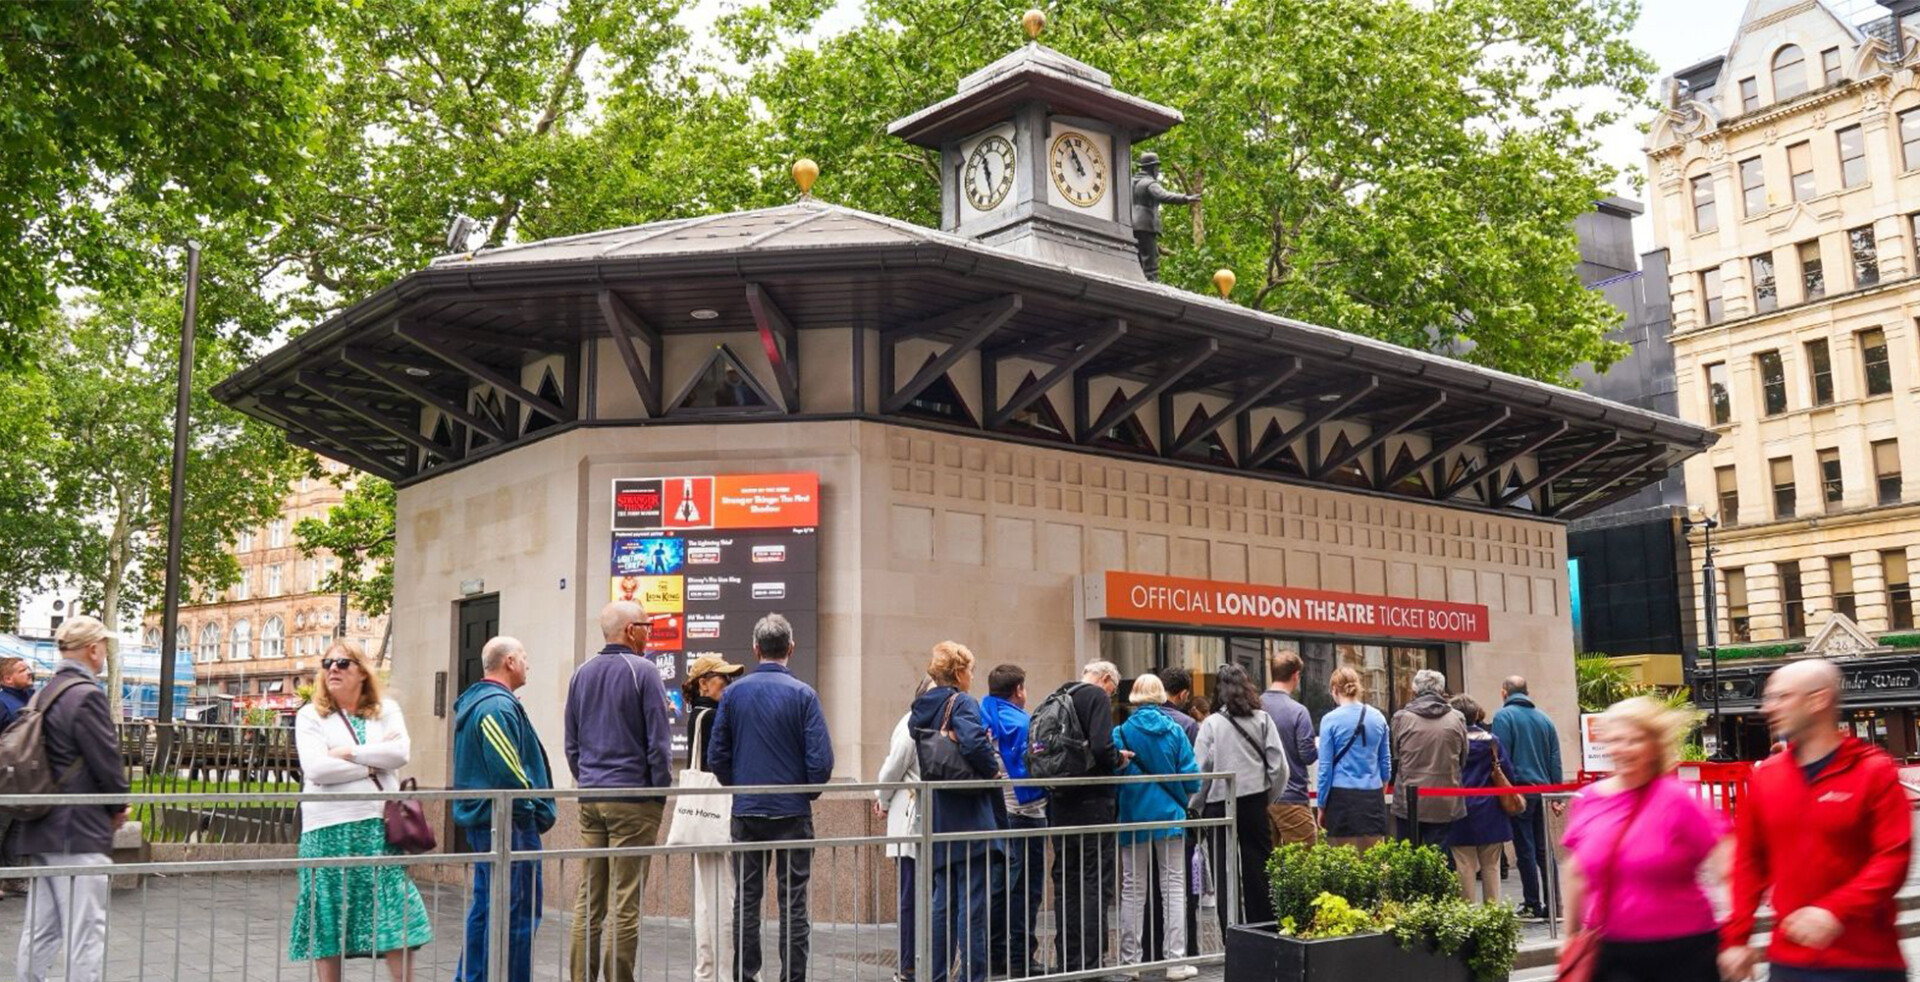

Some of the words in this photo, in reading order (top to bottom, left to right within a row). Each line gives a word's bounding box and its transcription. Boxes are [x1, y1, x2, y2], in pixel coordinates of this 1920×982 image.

[646, 593, 661, 602] LION
[1131, 585, 1212, 613] OFFICIAL
[1216, 592, 1301, 620] LONDON
[1305, 599, 1376, 625] THEATRE
[1379, 605, 1425, 629] TICKET
[1428, 610, 1477, 632] BOOTH
[1871, 674, 1911, 688] Water
[695, 808, 721, 819] Home
